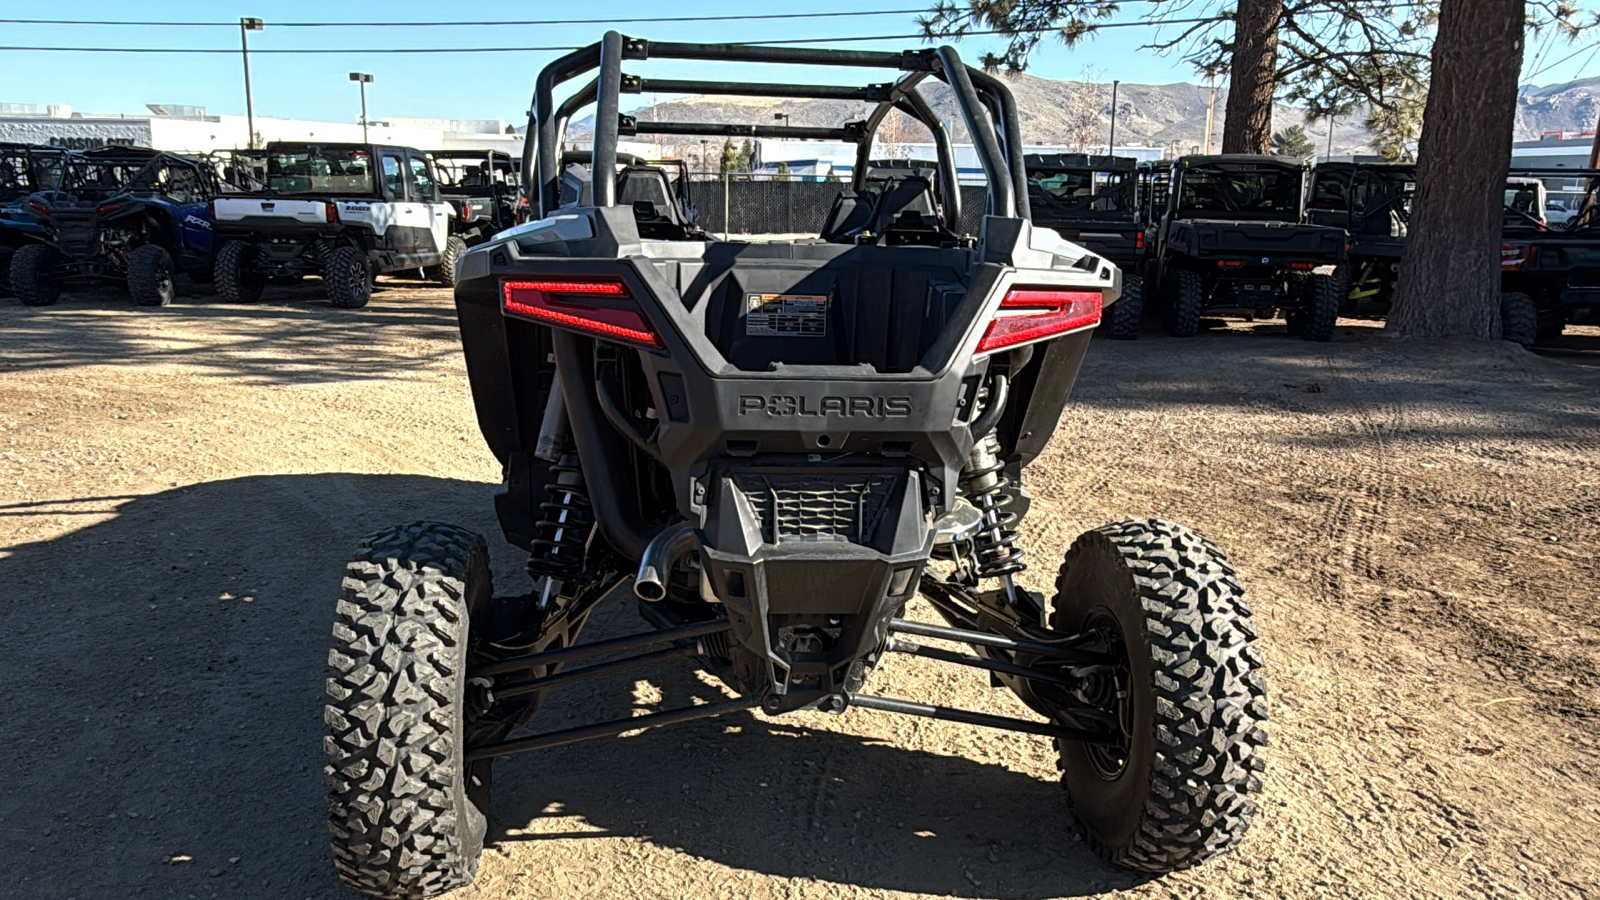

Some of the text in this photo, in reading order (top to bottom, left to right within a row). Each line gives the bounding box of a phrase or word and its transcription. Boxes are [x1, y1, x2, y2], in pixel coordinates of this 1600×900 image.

[50, 137, 136, 150] CARSON CITY
[185, 215, 212, 230] RZR
[737, 394, 913, 418] POLARIS
